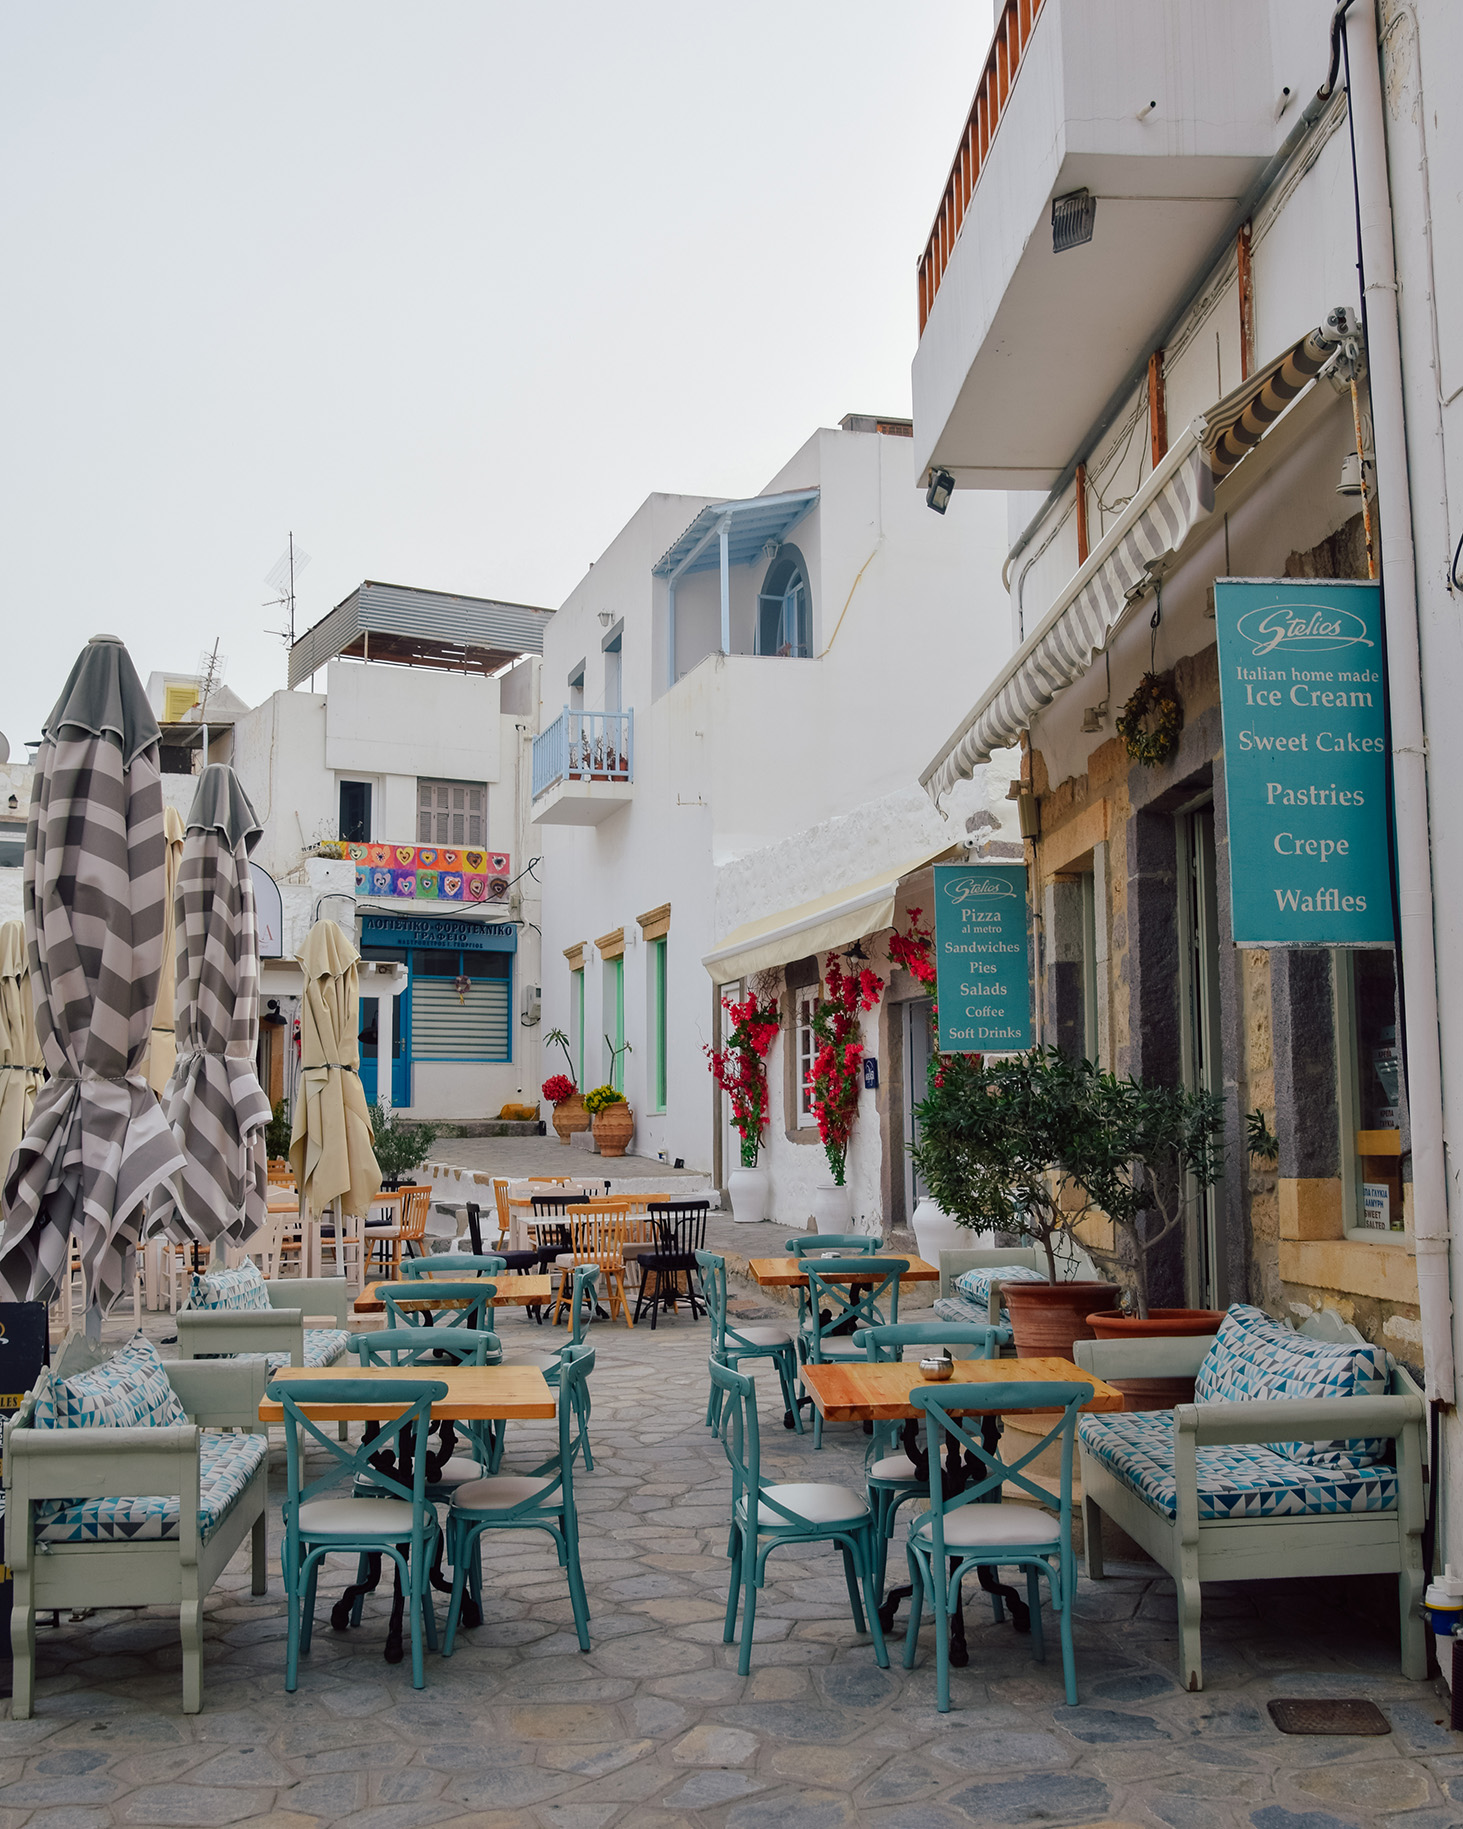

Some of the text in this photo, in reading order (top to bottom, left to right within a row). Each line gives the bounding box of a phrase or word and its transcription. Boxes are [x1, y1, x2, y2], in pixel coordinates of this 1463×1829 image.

[1252, 608, 1343, 656] Stelios
[1236, 666, 1379, 682] Italian home made
[1245, 684, 1373, 707] Ice Cream
[1239, 730, 1384, 752] Sweet Cakes
[1266, 783, 1365, 806] Pastries
[1274, 832, 1349, 863] Crepe
[951, 878, 1001, 905] Stelios
[1274, 887, 1367, 912] Waffles
[961, 908, 1001, 922] Pizza
[962, 924, 1002, 934] al metro
[413, 932, 468, 942] ΓΡΑΦΕΙΟ
[945, 941, 1020, 954] Sandwiches
[970, 961, 997, 974] Pies
[960, 982, 1008, 996] Salads
[966, 1005, 1005, 1018] Coffee
[949, 1026, 1022, 1039] Soft Drinks
[1363, 1209, 1381, 1219] SWEET
[1366, 1219, 1386, 1230] SALTED
